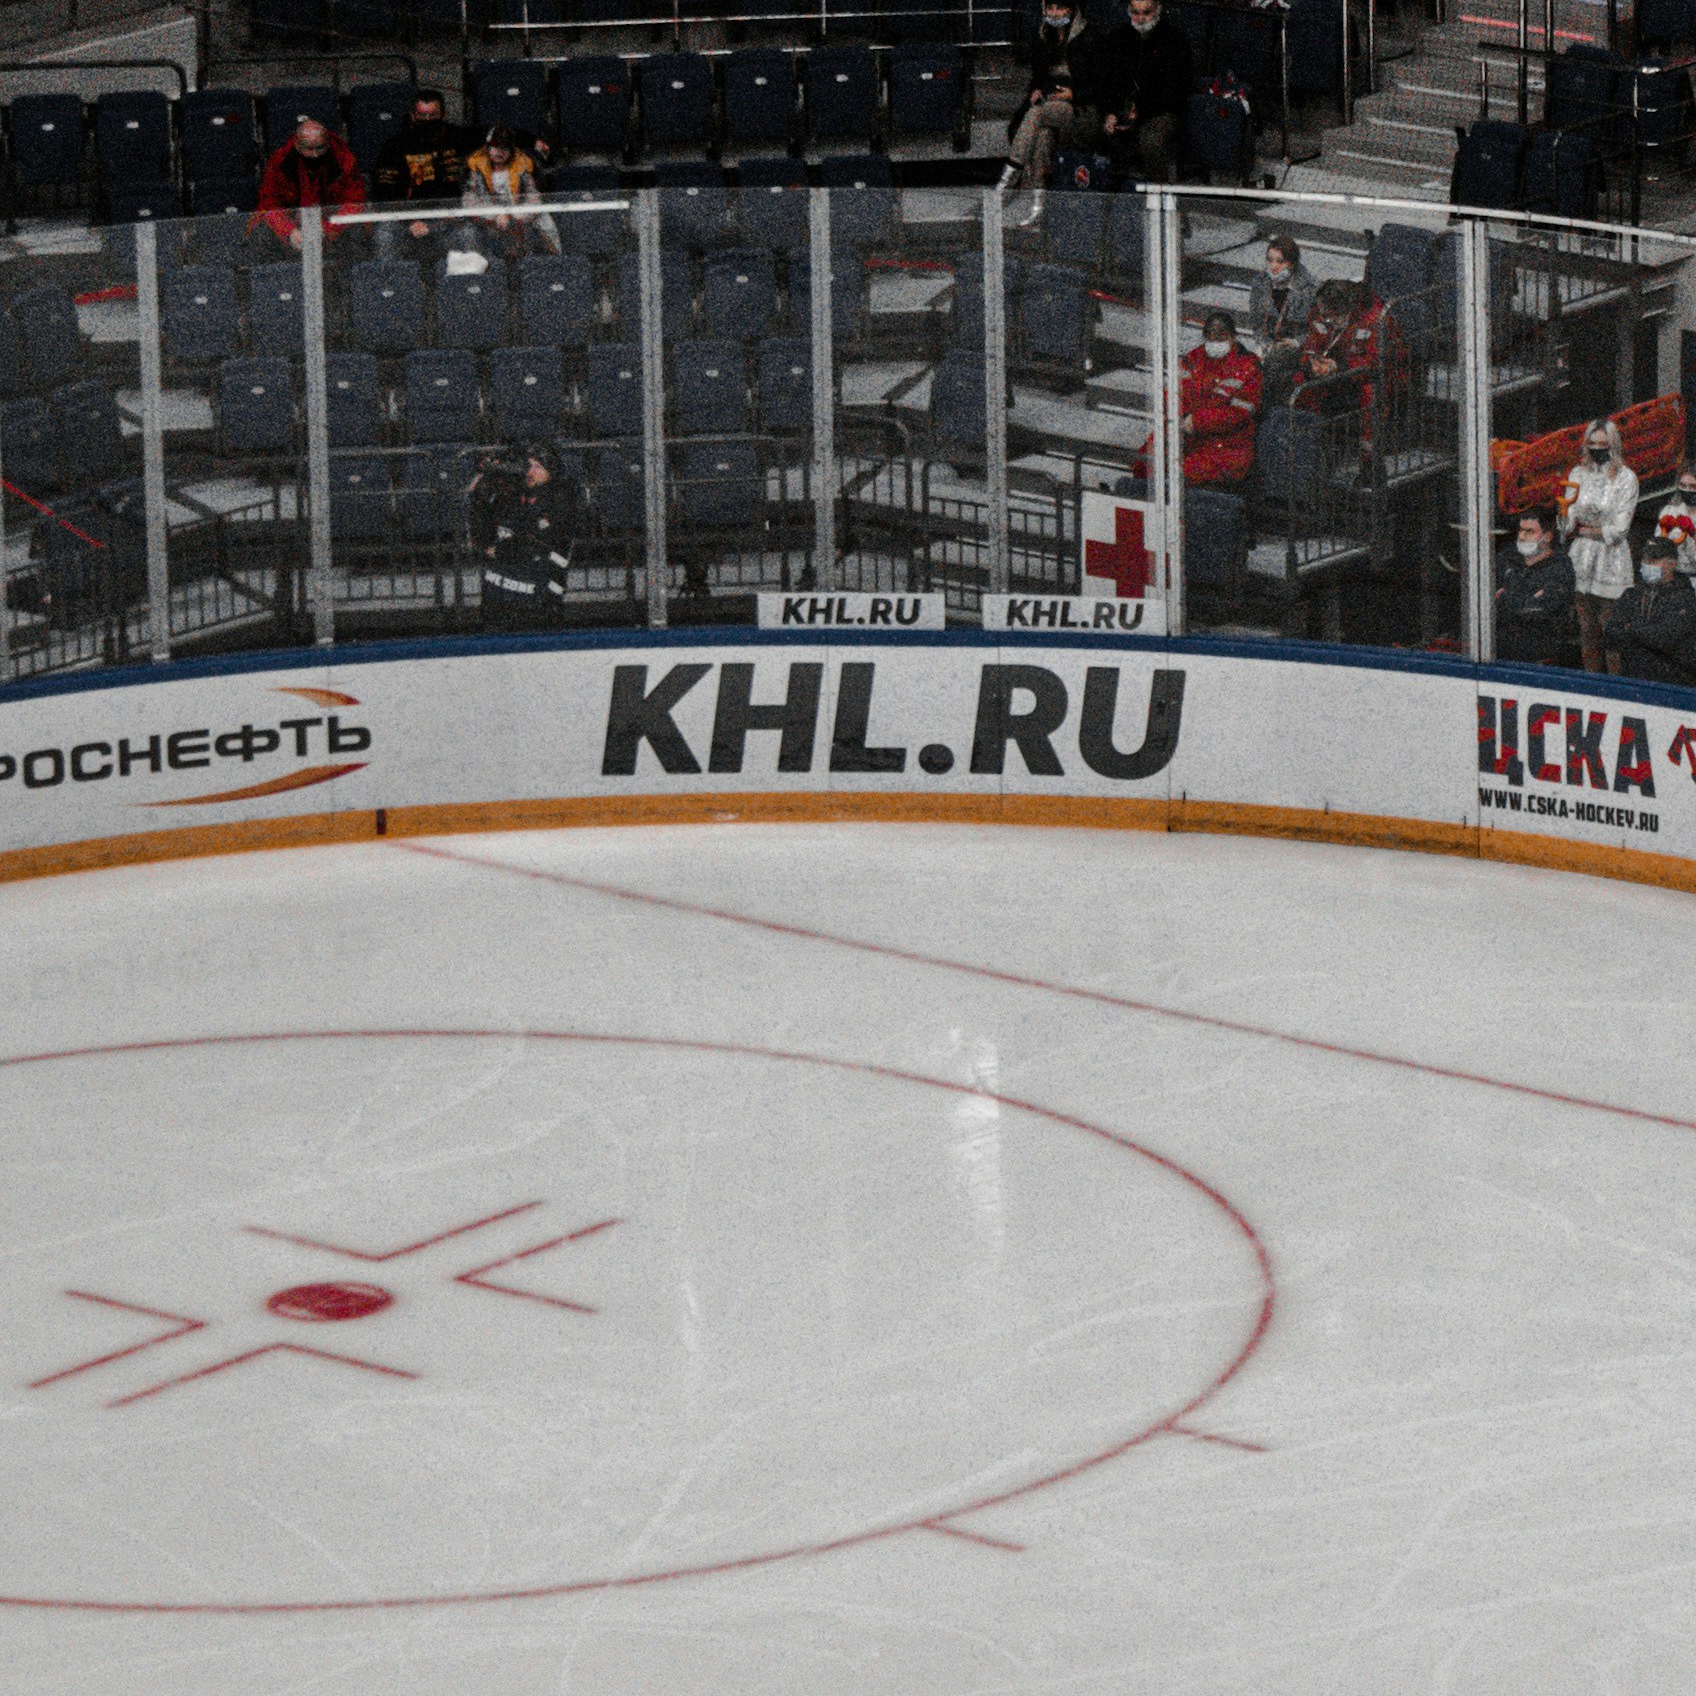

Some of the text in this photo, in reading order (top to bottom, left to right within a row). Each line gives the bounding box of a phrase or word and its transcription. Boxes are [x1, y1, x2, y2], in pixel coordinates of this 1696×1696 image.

[782, 597, 922, 626] KHL.RU
[1006, 599, 1145, 630] KHL.RU
[601, 662, 1187, 780] KHL.RU
[1477, 695, 1656, 798] ЦСКА
[1478, 787, 1660, 833] WWW.CSKA-HOCKEY.RU
